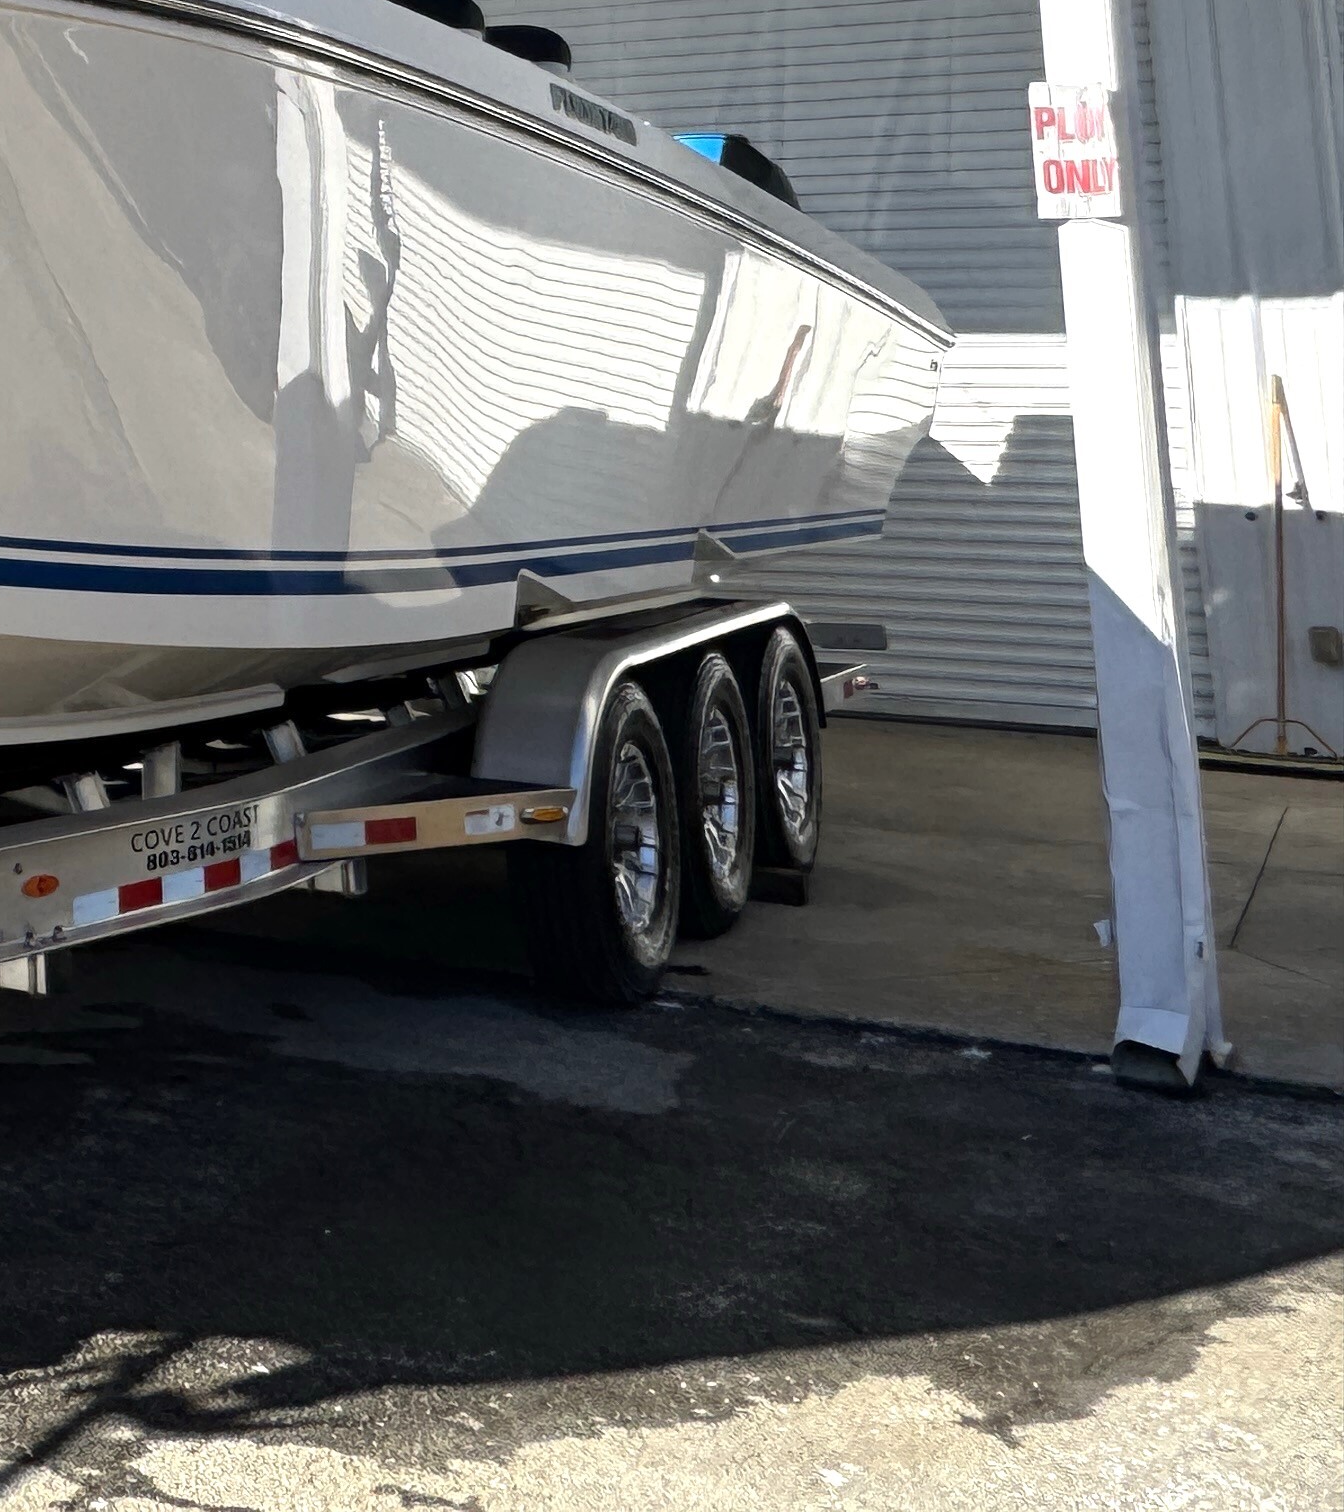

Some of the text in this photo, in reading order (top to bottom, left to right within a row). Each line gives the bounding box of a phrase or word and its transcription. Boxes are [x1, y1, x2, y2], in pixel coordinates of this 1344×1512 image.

[1043, 157, 1116, 195] ONLY
[131, 804, 259, 853] COVE 2 COAST
